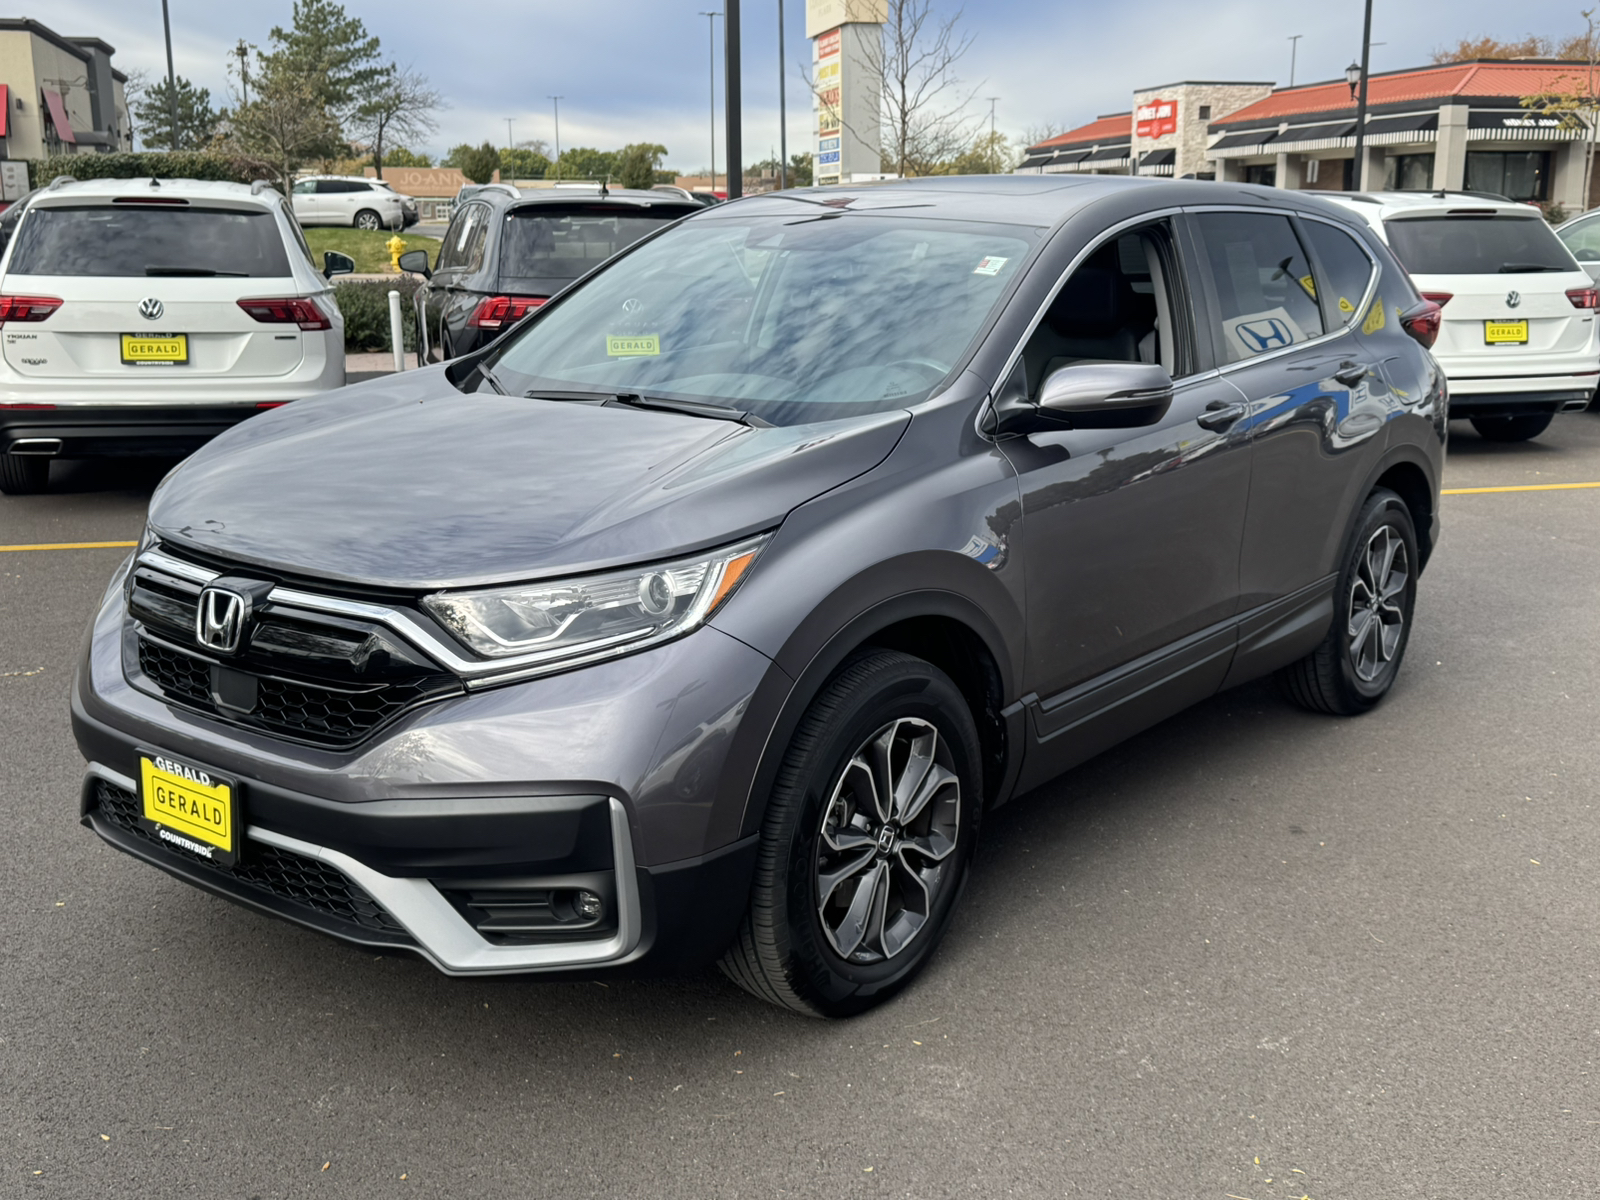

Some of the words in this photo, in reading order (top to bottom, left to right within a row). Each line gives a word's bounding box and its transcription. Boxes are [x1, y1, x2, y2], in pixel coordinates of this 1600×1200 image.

[1490, 328, 1521, 336] GERALD
[131, 345, 178, 353] GERALD
[613, 342, 653, 350] GERALD
[155, 757, 211, 786] GERALD
[156, 786, 222, 825] GERALD
